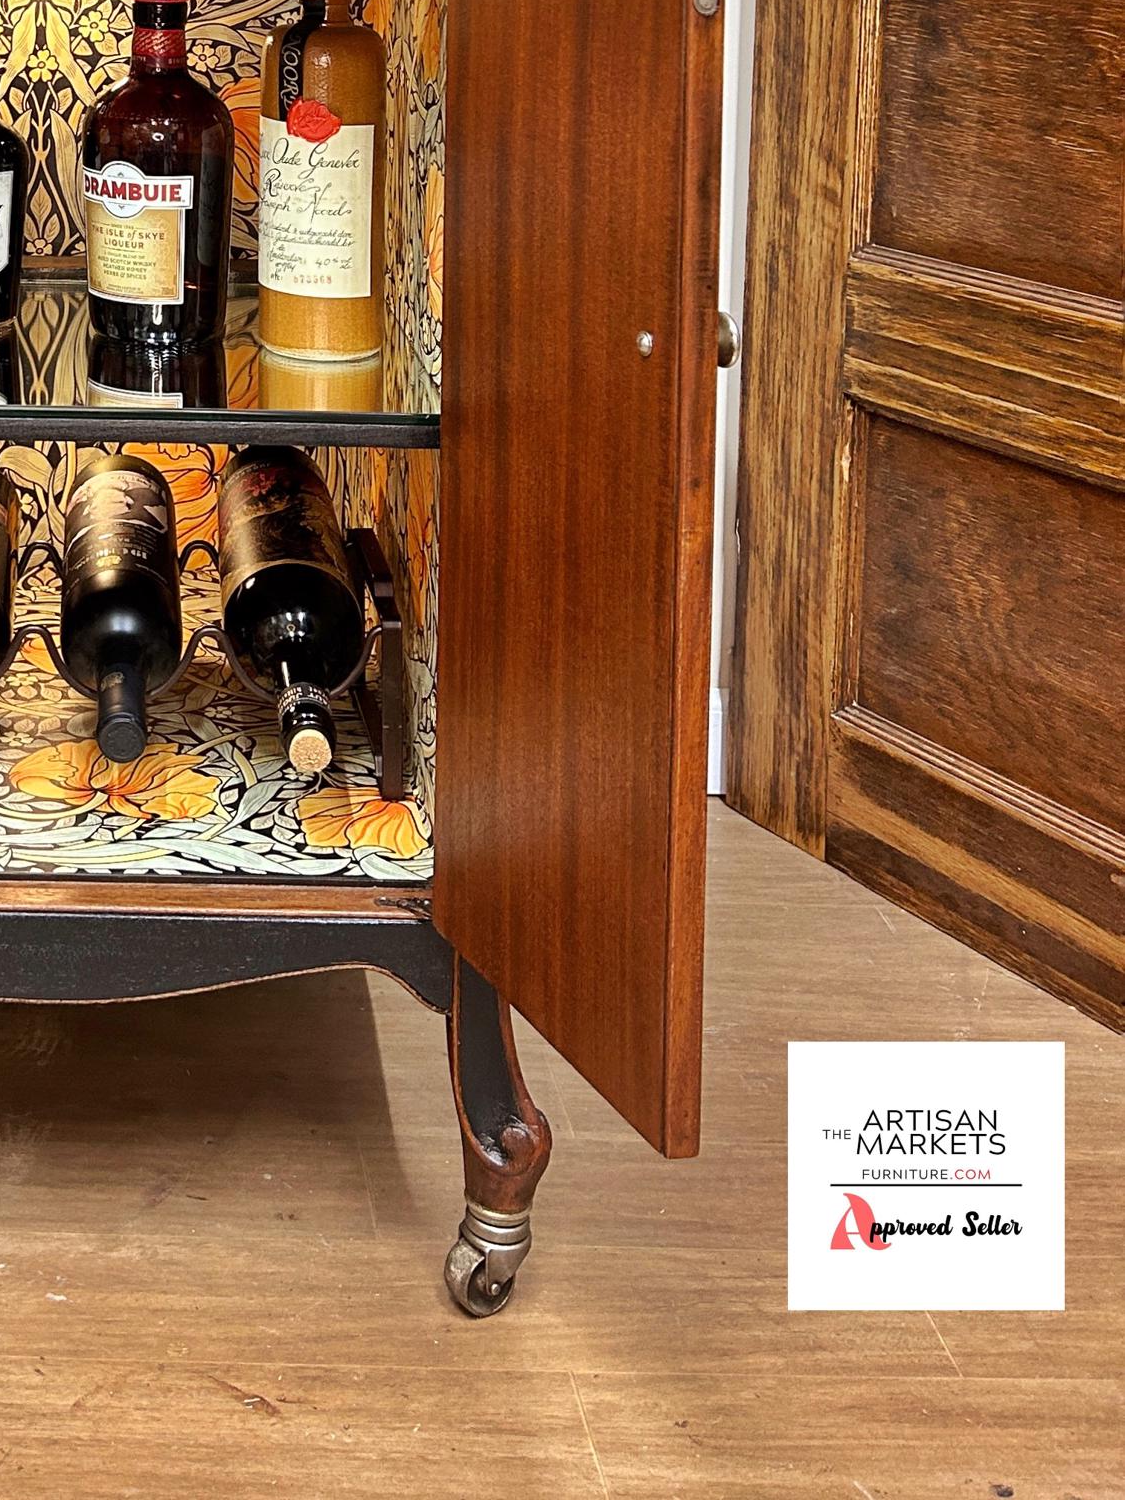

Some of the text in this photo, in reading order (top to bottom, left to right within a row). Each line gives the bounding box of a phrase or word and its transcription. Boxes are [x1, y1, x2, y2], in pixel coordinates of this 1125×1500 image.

[84, 174, 182, 202] DRAMBUIE
[106, 228, 125, 237] ISLE
[127, 230, 137, 241] of
[138, 232, 165, 241] SKYE
[104, 237, 145, 249] LIQUEUR
